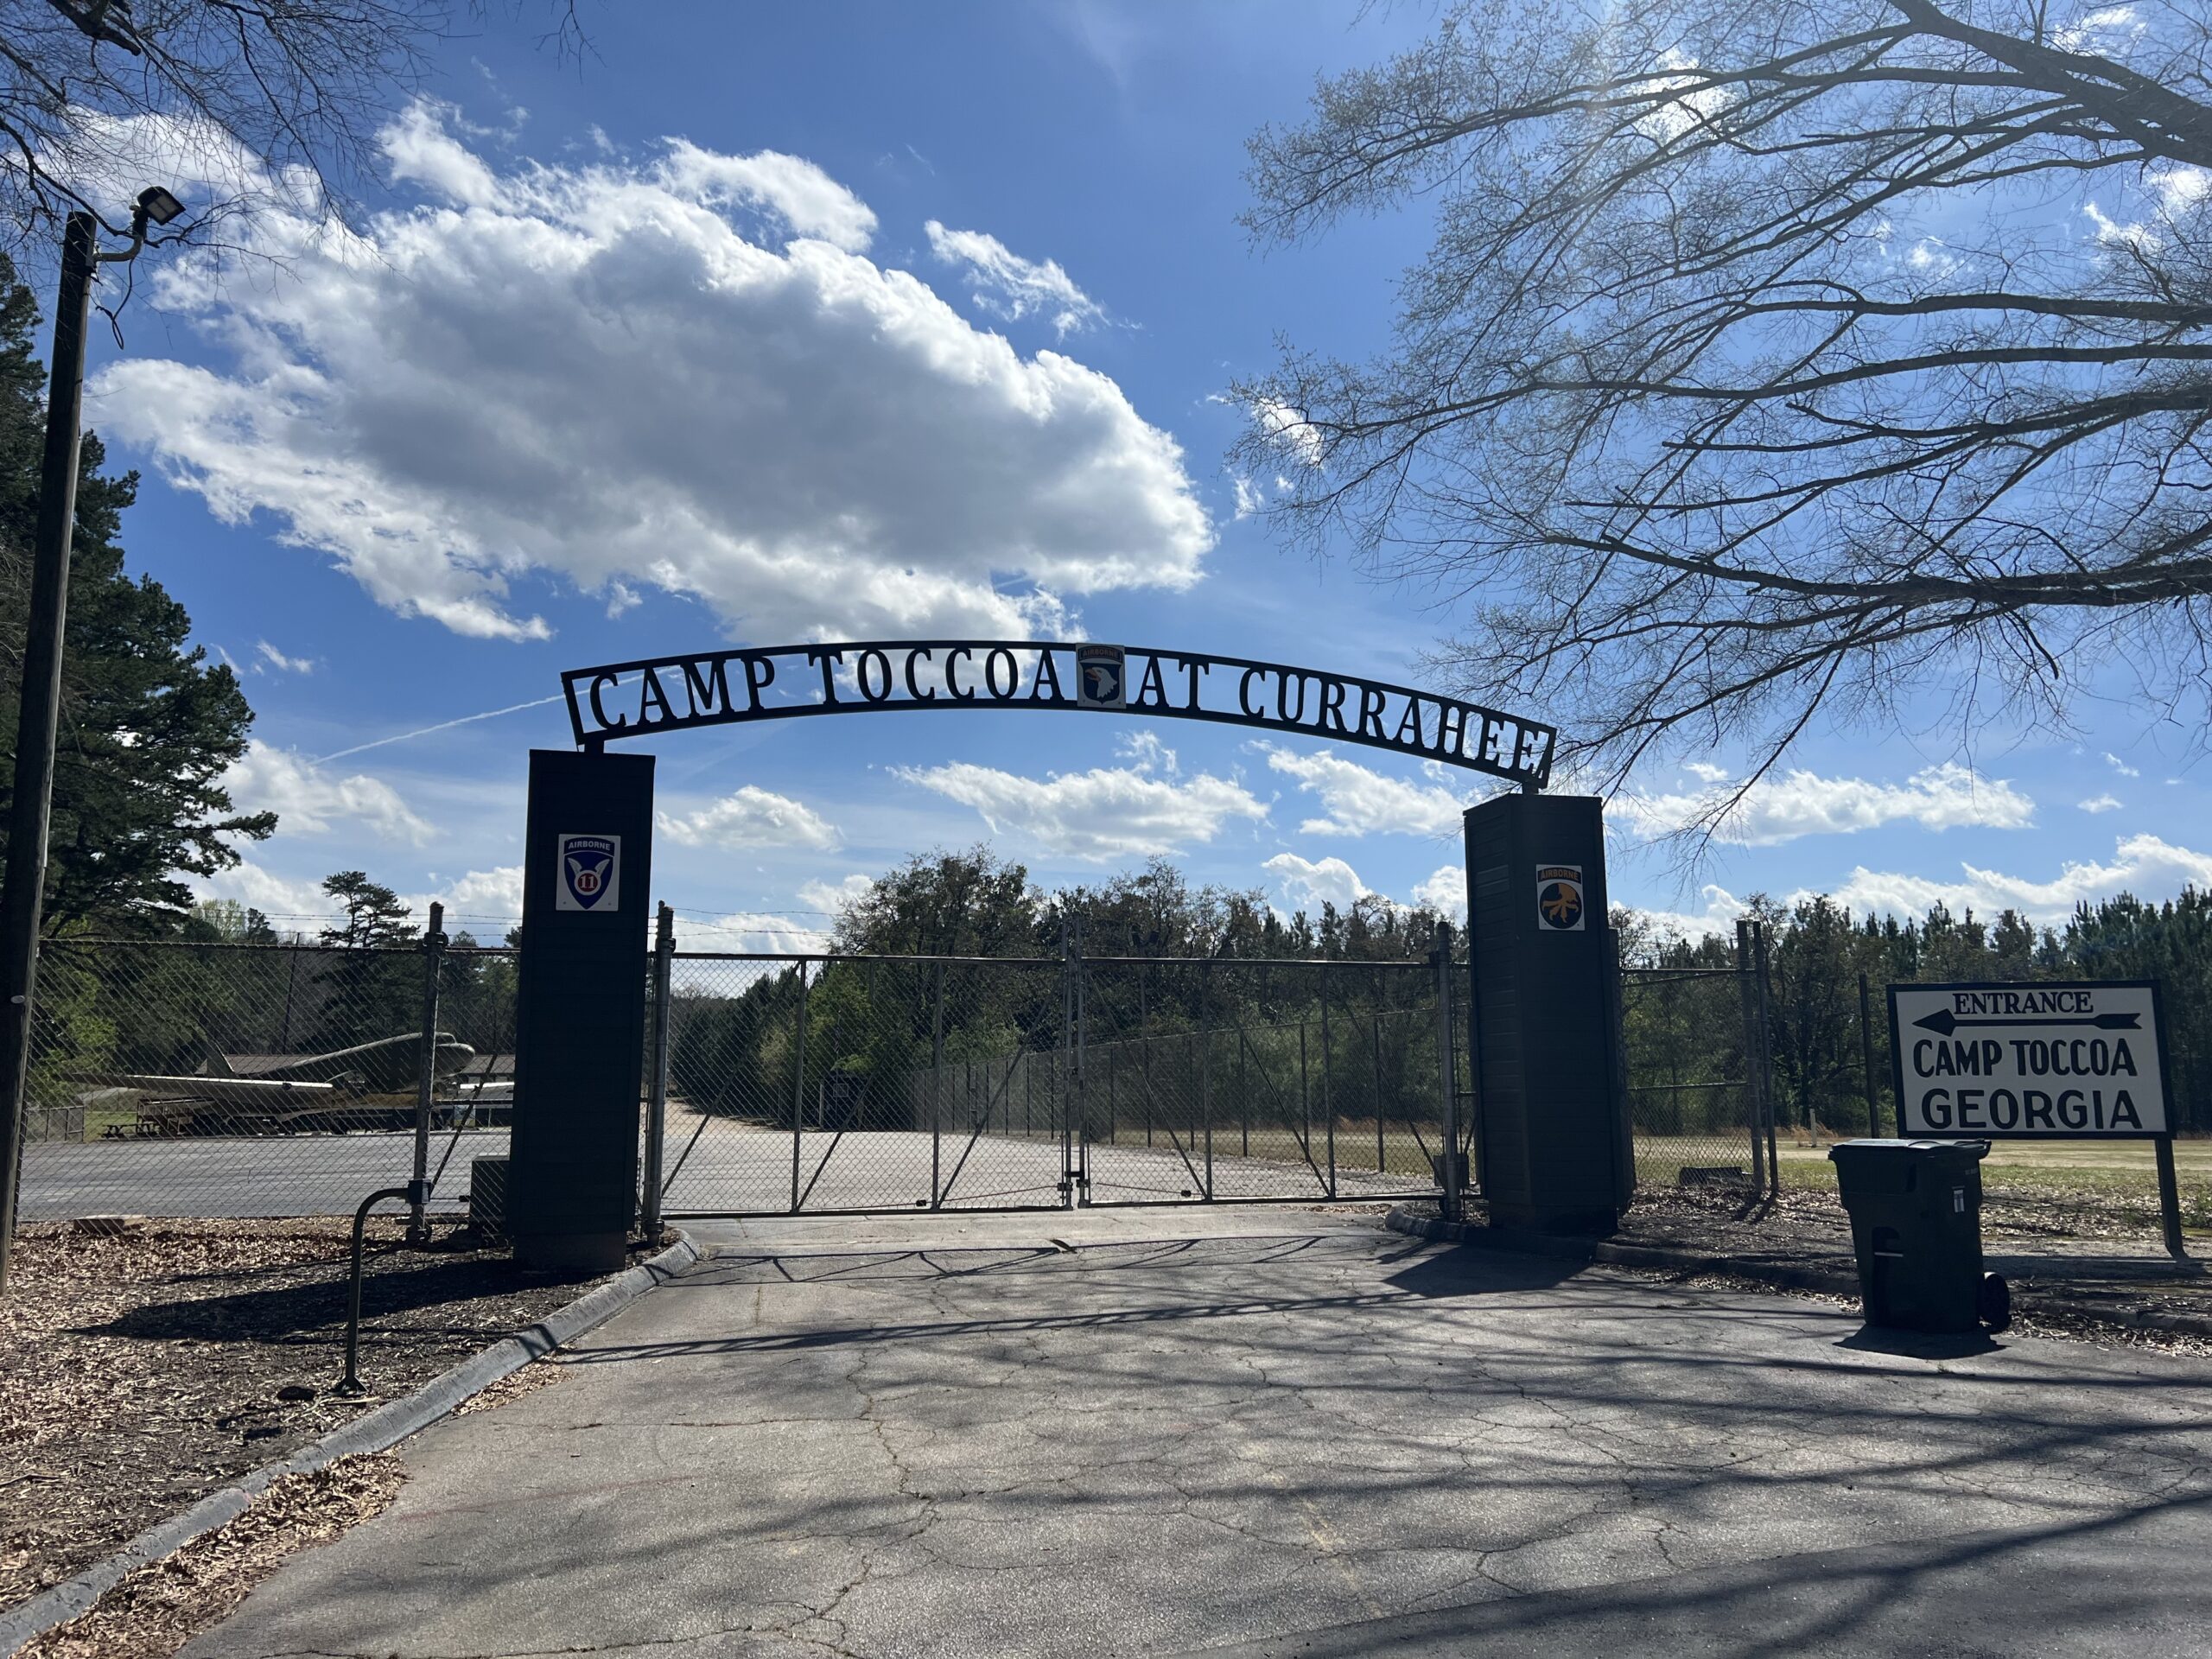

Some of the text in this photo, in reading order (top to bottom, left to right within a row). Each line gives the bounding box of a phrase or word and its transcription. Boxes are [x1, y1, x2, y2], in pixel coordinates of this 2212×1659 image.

[589, 648, 1544, 775] CAMP TOCCOA AT CURRAHEE
[568, 840, 610, 851] AIRBORNE
[579, 874, 595, 889] 11
[1541, 869, 1580, 880] AIRBORNE
[1953, 991, 2094, 1014] ENTRANCE
[1913, 1038, 2138, 1078] CAMP TOCCOA
[1921, 1088, 2143, 1130] GEORGIA
